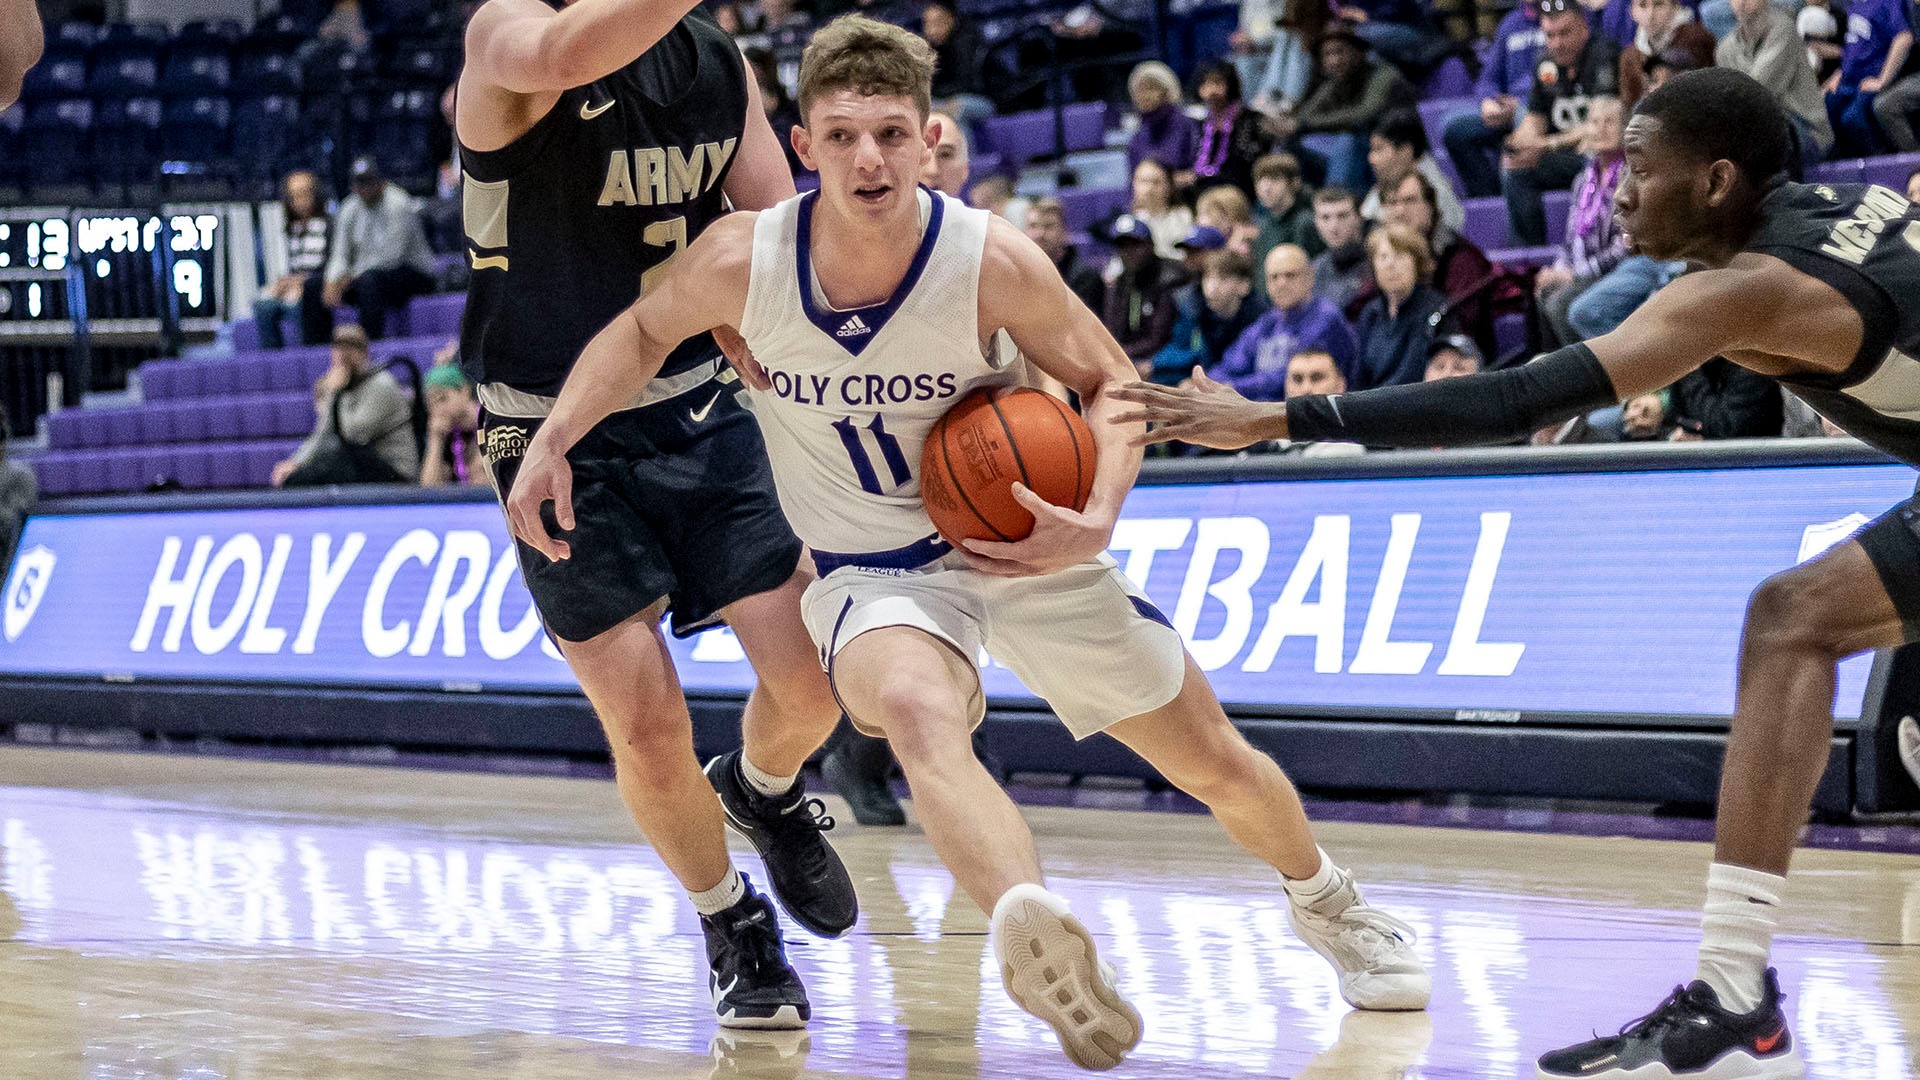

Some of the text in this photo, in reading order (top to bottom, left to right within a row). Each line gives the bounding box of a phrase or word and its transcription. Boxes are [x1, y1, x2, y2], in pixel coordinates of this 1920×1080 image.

[597, 137, 737, 206] ARMY
[172, 259, 202, 308] 9
[836, 327, 871, 336] adidas
[764, 366, 957, 406] OLY CROSS
[831, 412, 912, 495] 11
[130, 511, 1526, 676] HOLY CRO TBALL
